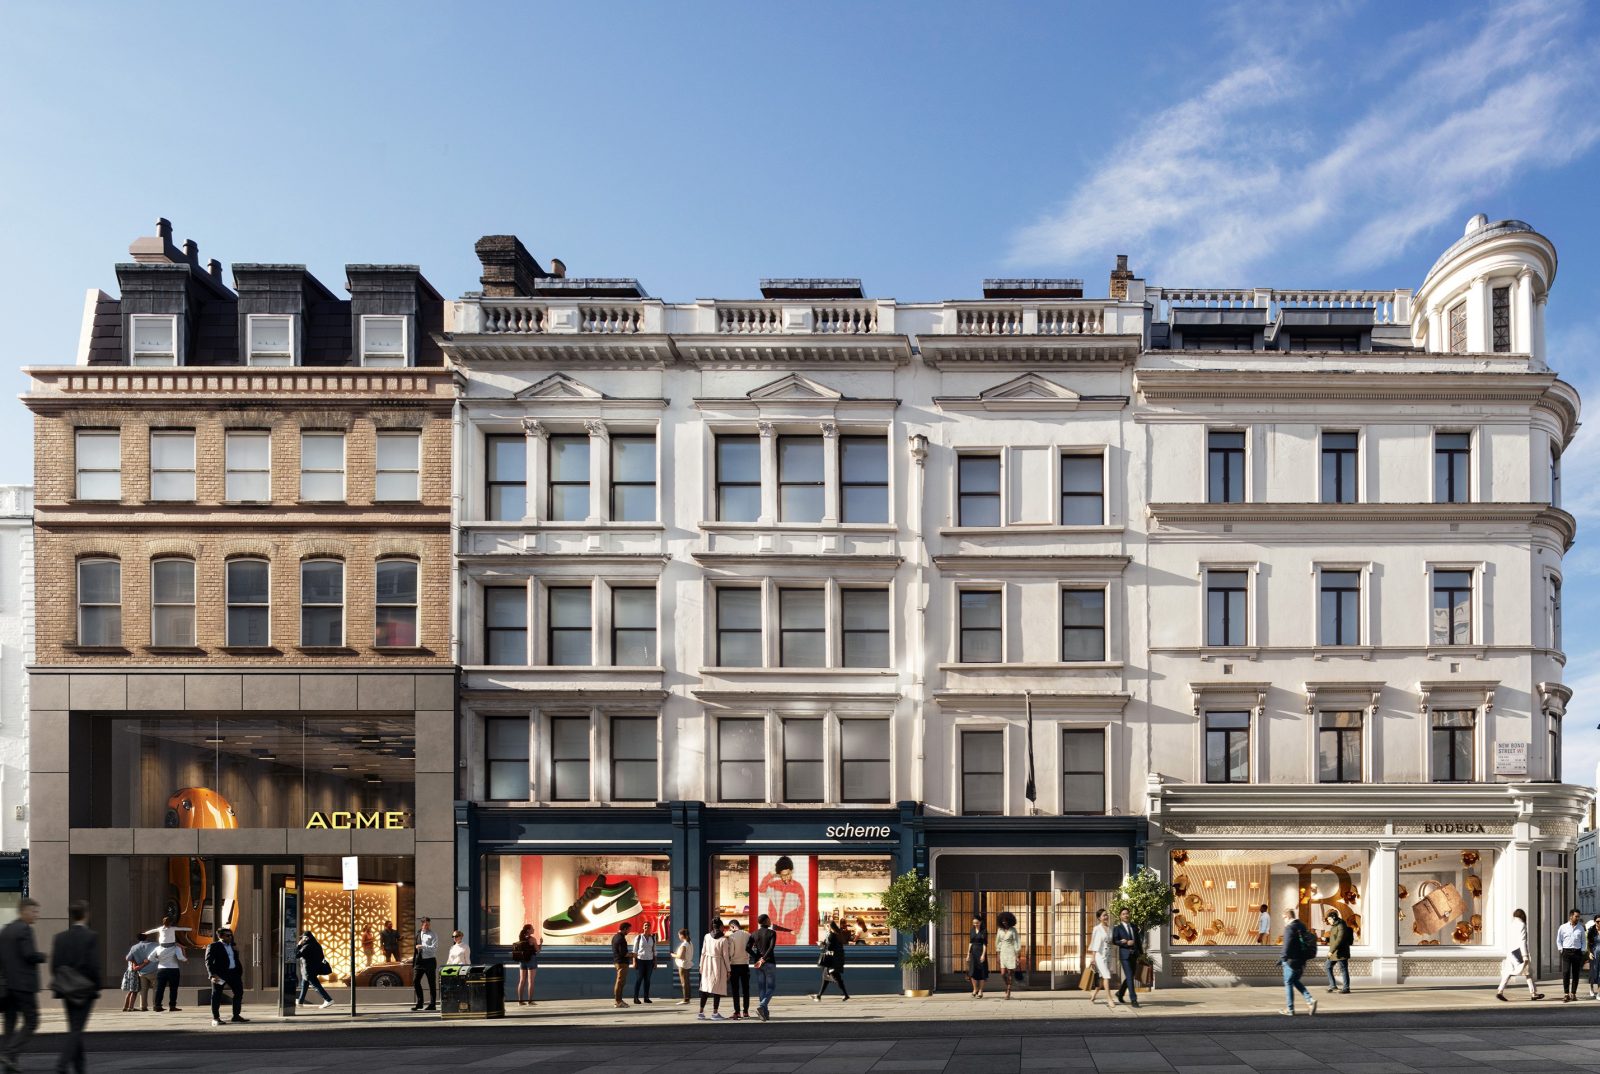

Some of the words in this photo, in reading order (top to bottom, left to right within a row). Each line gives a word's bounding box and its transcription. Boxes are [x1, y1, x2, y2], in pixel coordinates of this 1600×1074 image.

[305, 811, 404, 830] ACME
[1424, 823, 1486, 834] BODEGA
[825, 822, 891, 838] scheme
